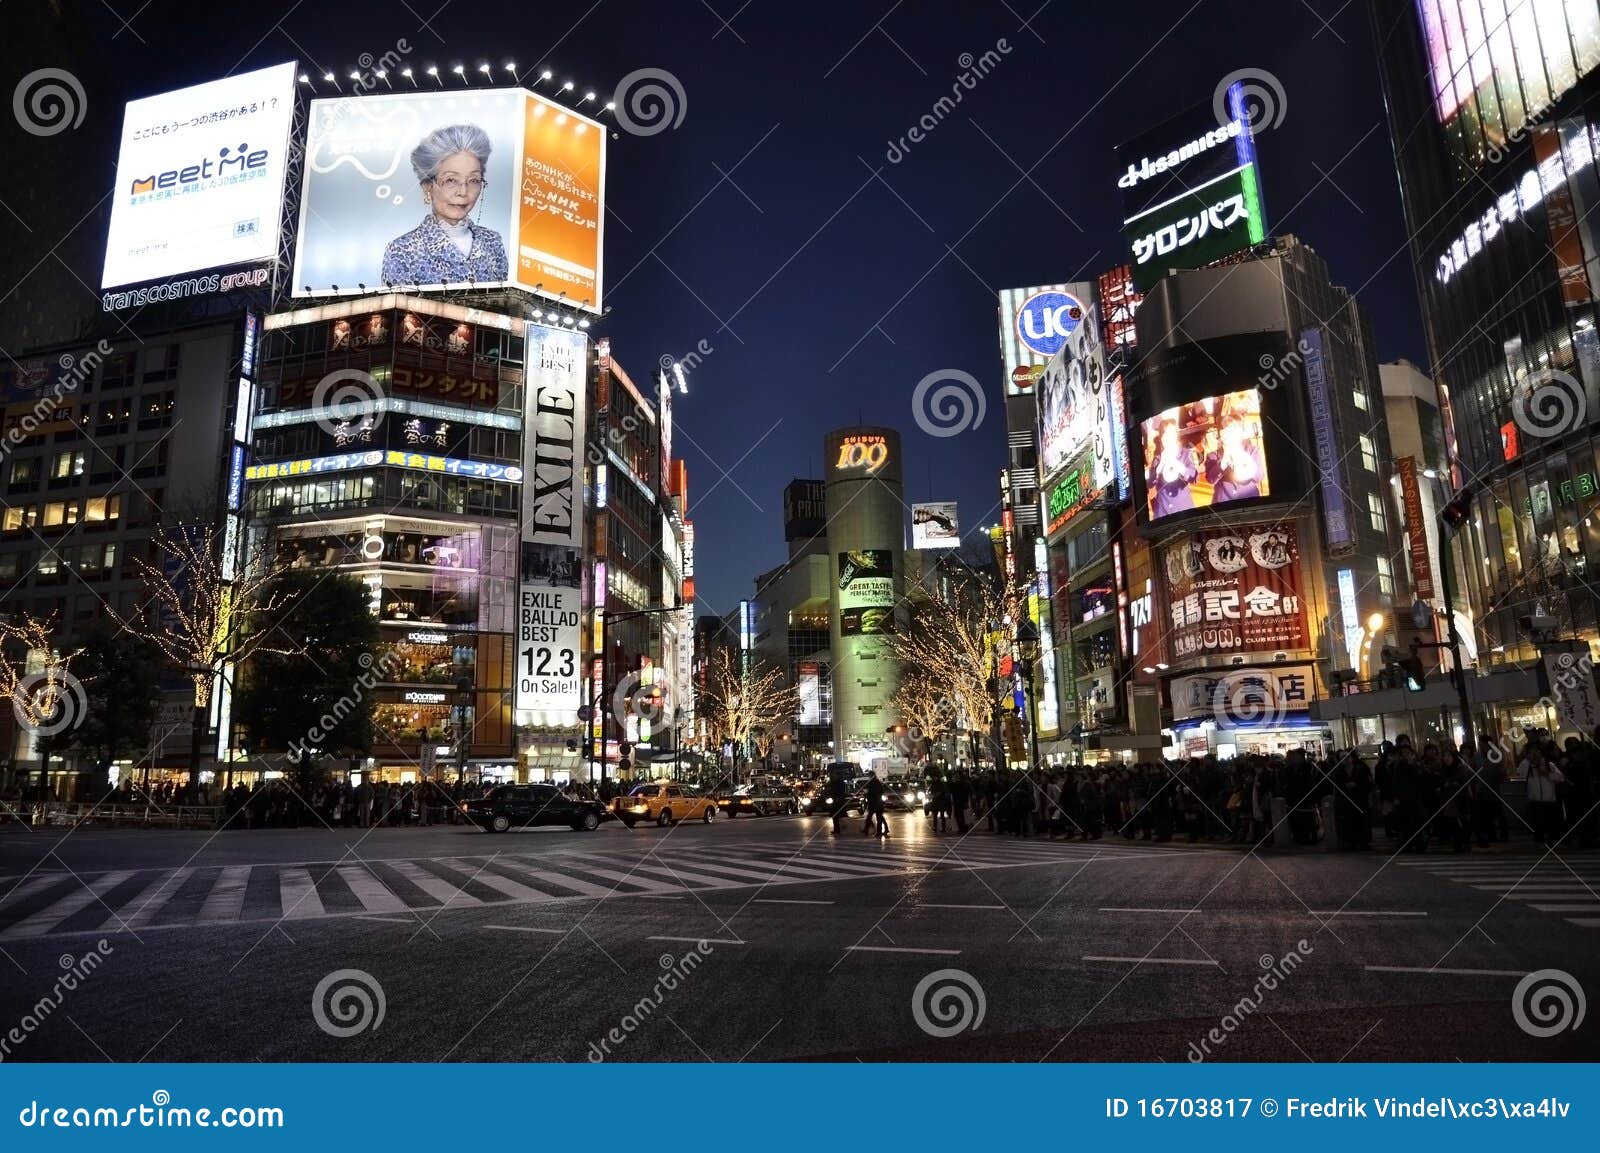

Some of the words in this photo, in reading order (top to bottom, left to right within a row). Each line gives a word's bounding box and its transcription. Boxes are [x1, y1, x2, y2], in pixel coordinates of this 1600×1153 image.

[1131, 193, 1249, 265] サロンパス
[102, 273, 219, 312] transcosmos
[220, 268, 269, 292] group
[533, 386, 575, 539] EXILE
[836, 443, 889, 473] 109
[522, 592, 562, 609] EXILE
[522, 609, 578, 627] BALLAD
[522, 626, 559, 642] BEST
[521, 647, 575, 677] 12.3
[521, 679, 538, 693] On
[542, 679, 578, 694] Sale!!
